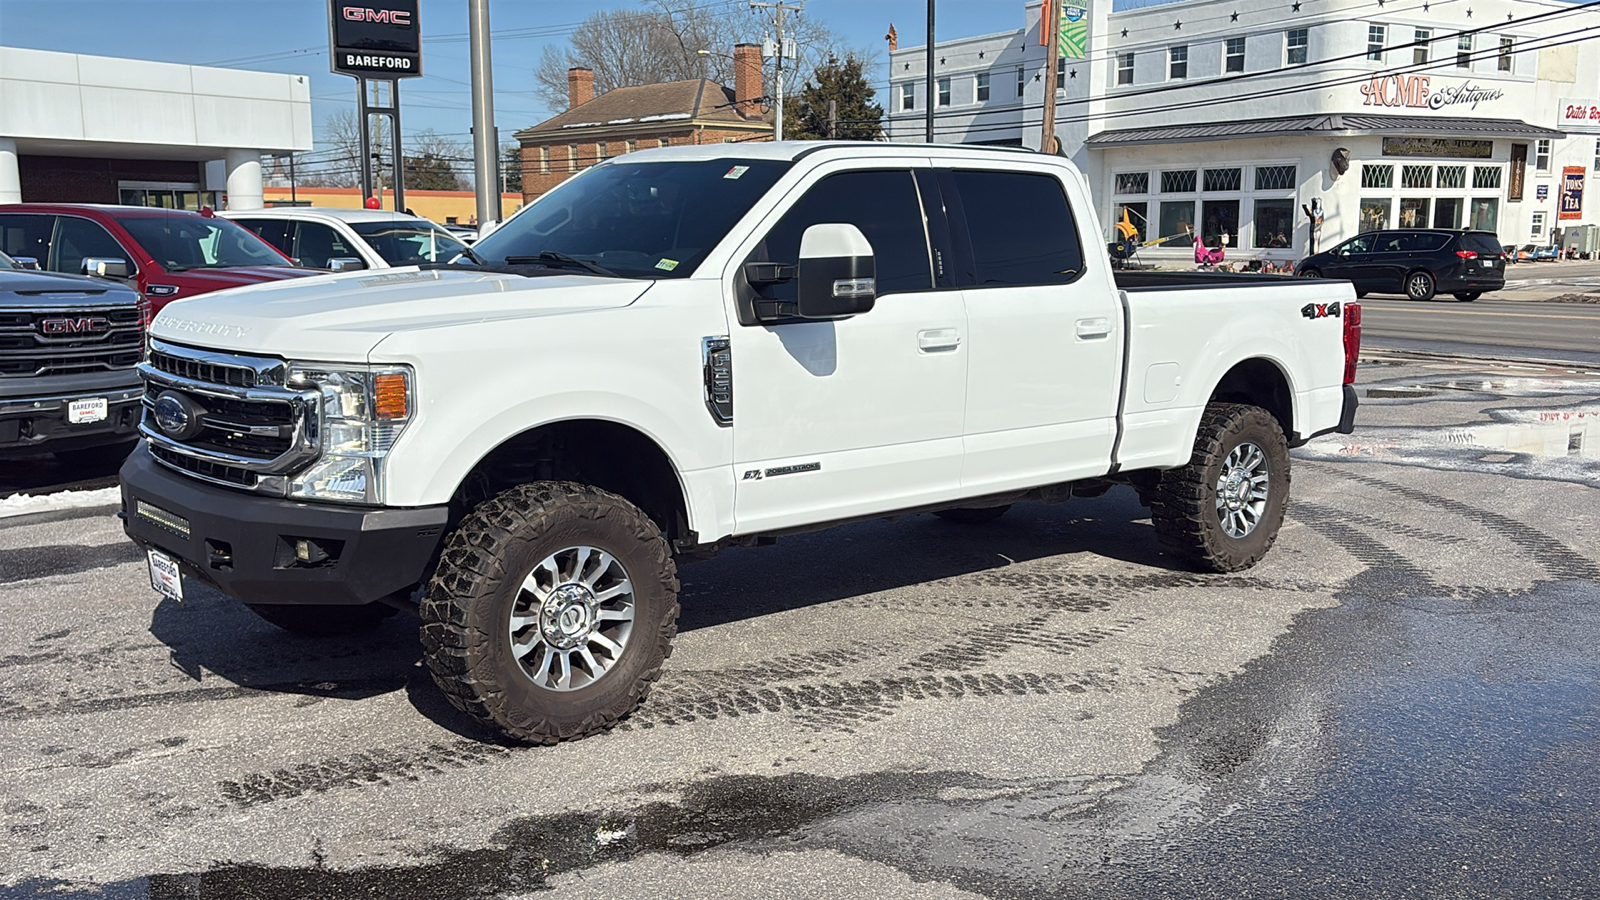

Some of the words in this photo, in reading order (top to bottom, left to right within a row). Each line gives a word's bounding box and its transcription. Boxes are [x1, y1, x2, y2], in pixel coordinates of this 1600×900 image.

[343, 7, 411, 25] GMC
[346, 55, 411, 69] BAREFORD
[1360, 74, 1431, 108] ACME
[1565, 105, 1588, 120] Dutch
[42, 317, 107, 333] GMC
[72, 402, 104, 411] BAREFORD
[792, 461, 820, 472] STROKE
